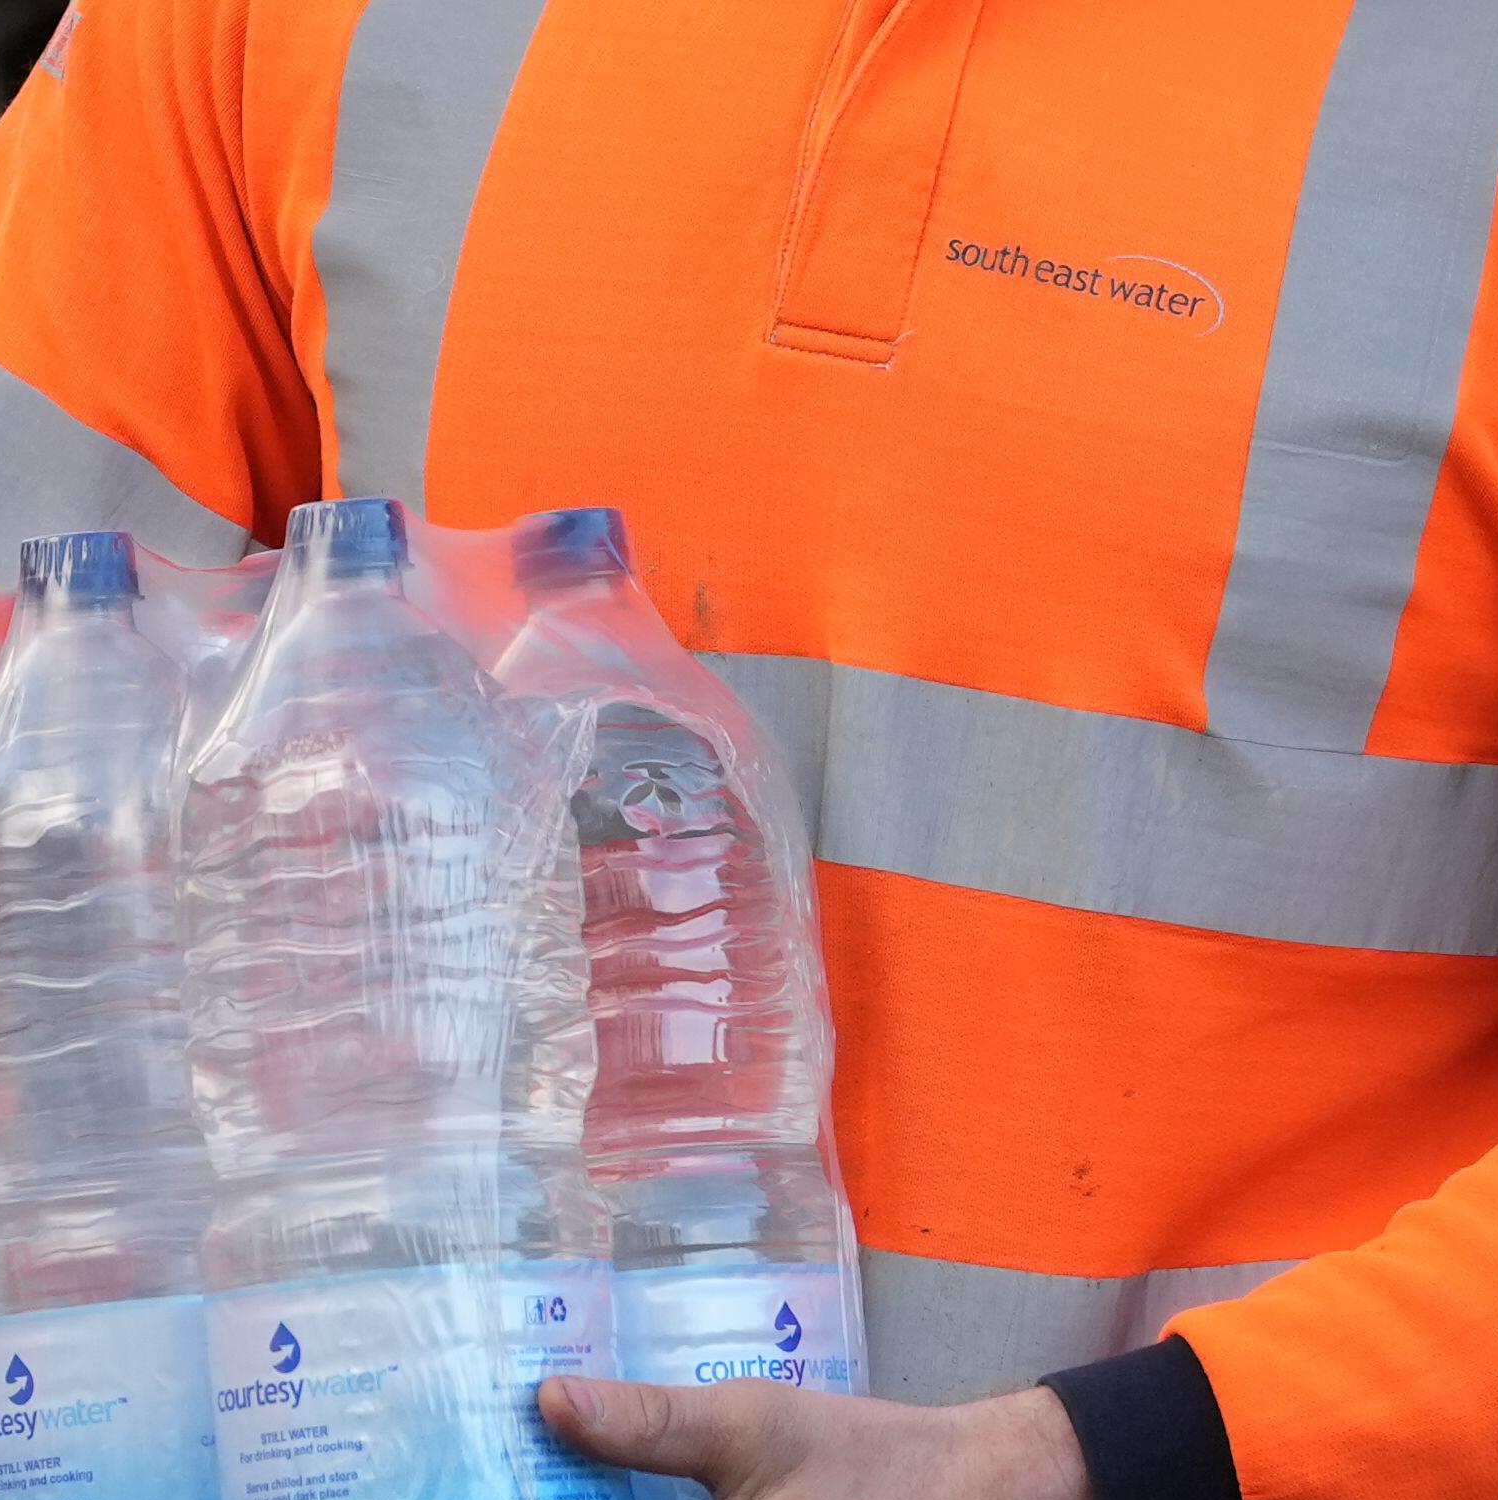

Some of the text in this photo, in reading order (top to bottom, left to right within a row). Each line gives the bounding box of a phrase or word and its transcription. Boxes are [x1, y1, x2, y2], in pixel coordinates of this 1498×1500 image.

[946, 238, 1206, 317] south east water
[260, 1425, 329, 1445] STILL WATER
[255, 1446, 292, 1461] drinking
[293, 1443, 313, 1456] and
[316, 1438, 363, 1453] cooking
[24, 1456, 61, 1472] WATER
[28, 1474, 47, 1487] and
[49, 1469, 93, 1484] cooking
[305, 1472, 325, 1486] and
[328, 1469, 358, 1482] store
